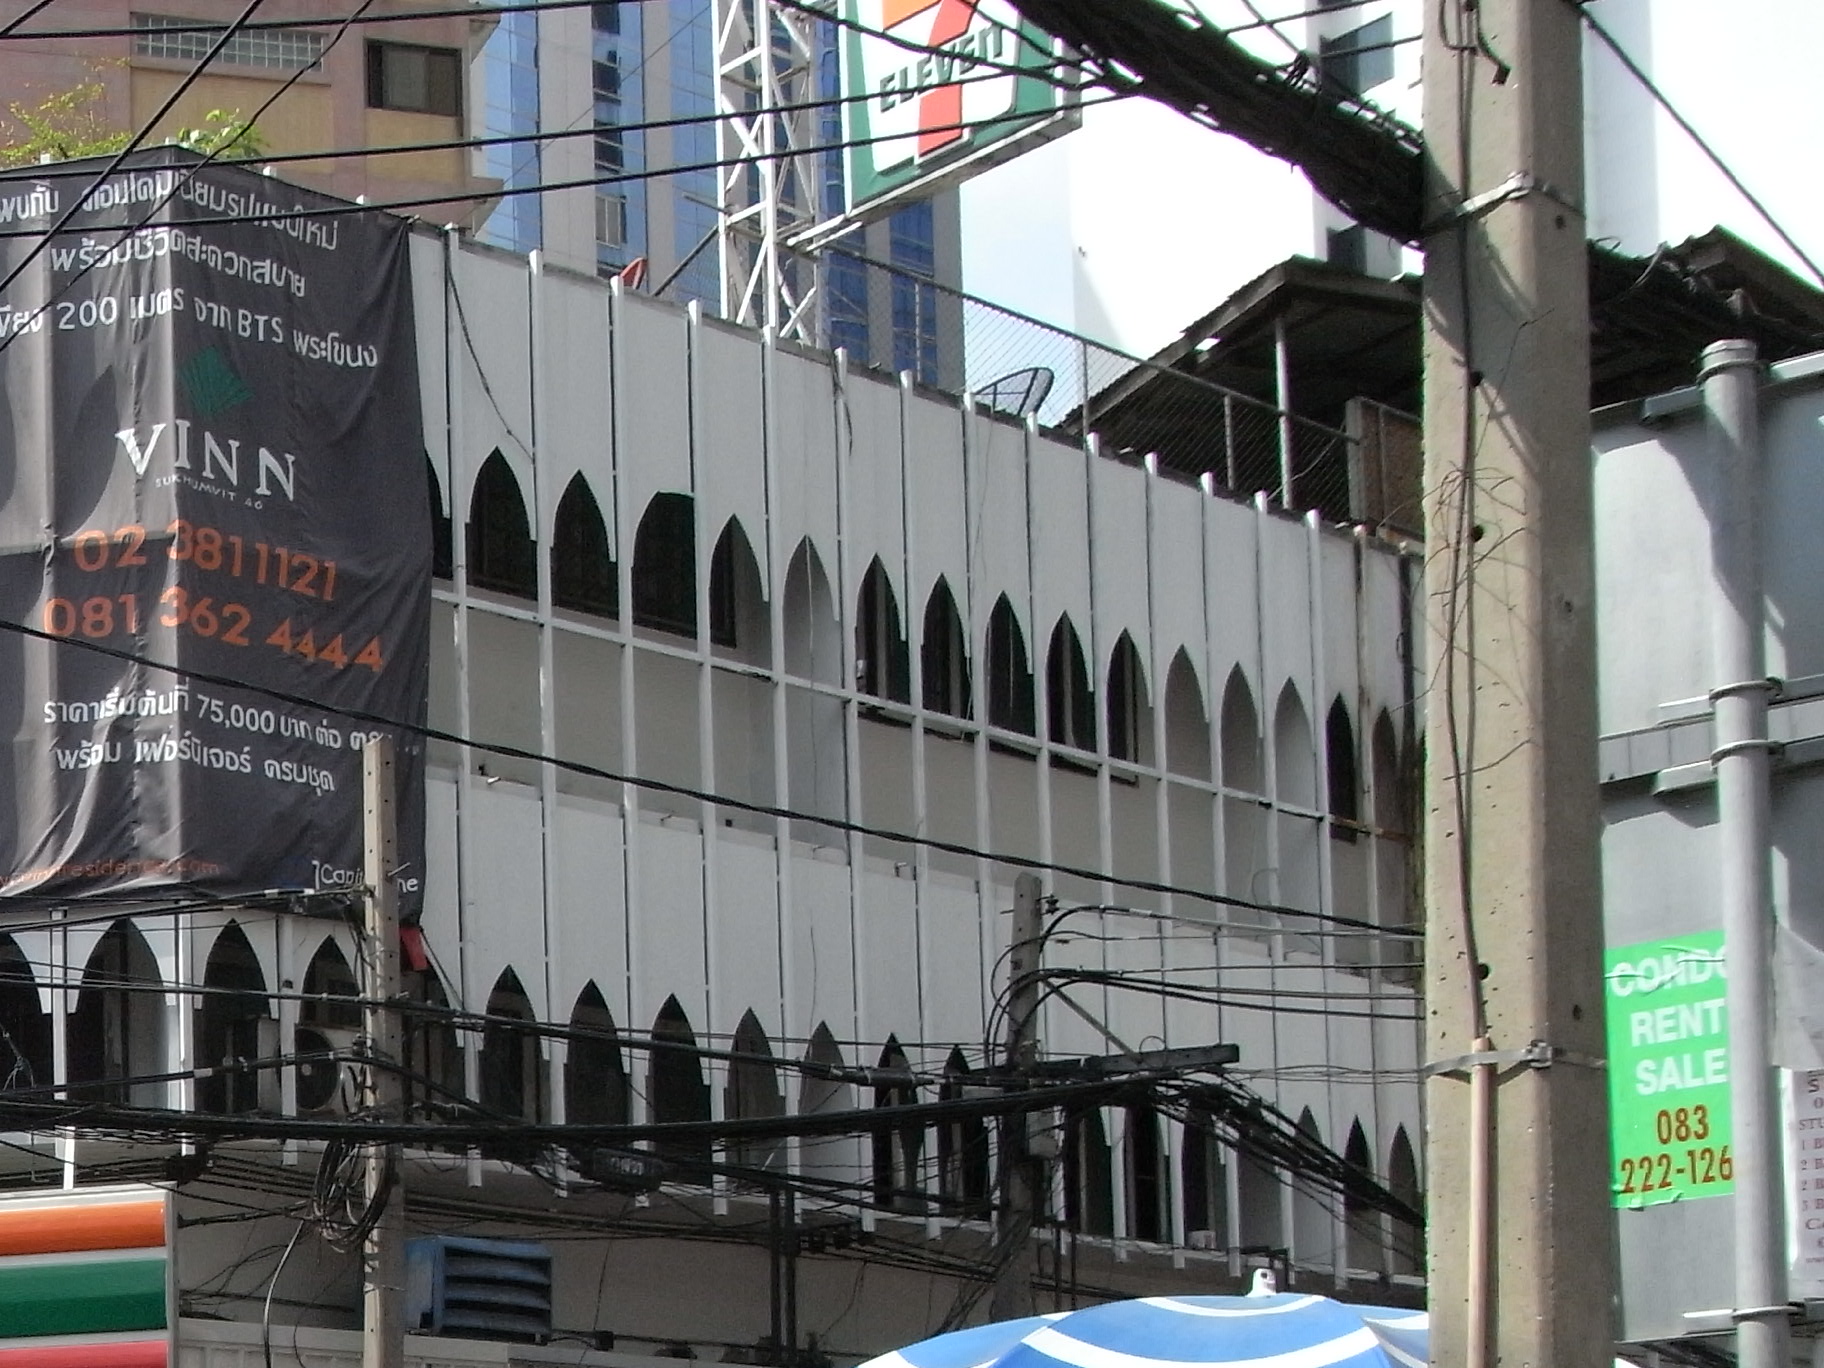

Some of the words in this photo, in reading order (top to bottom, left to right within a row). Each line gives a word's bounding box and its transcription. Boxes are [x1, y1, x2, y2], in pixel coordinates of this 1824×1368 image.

[57, 295, 119, 332] 200
[193, 296, 234, 332] จาก
[237, 308, 284, 345] BTS
[115, 419, 295, 502] VINN
[75, 523, 147, 573] 02
[43, 593, 137, 640] 081
[160, 585, 254, 648] 362
[266, 618, 384, 674] 4444
[196, 694, 276, 736] 75,000
[1630, 997, 1727, 1048] RENT
[1635, 1047, 1728, 1097] SALE
[1656, 1103, 1710, 1146] 083
